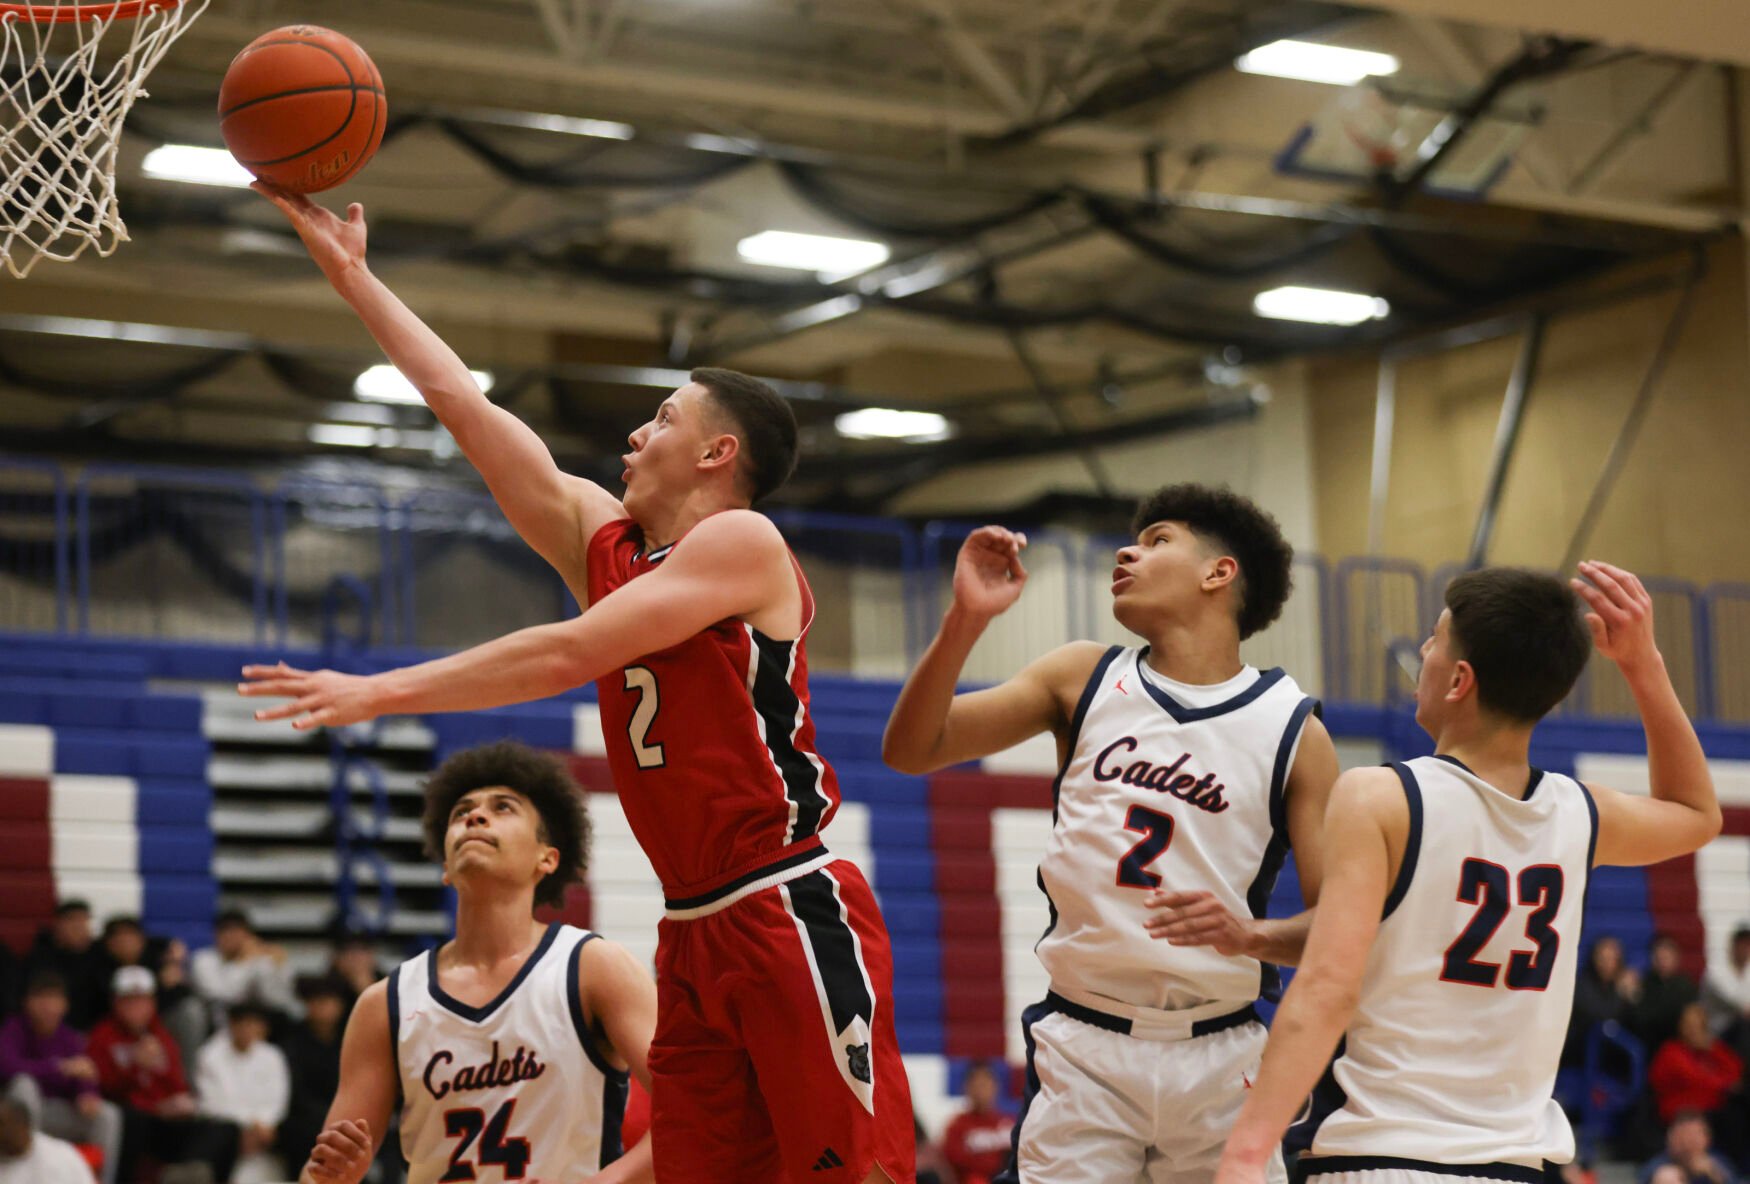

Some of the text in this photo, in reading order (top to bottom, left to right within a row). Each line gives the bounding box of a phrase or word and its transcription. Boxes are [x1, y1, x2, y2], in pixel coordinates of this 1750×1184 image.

[623, 664, 665, 770] 2
[1093, 736, 1229, 814] Cadets
[1116, 804, 1175, 890] 2
[1439, 857, 1564, 991] 23
[423, 1041, 545, 1100] Cadets
[438, 1098, 531, 1184] 24
